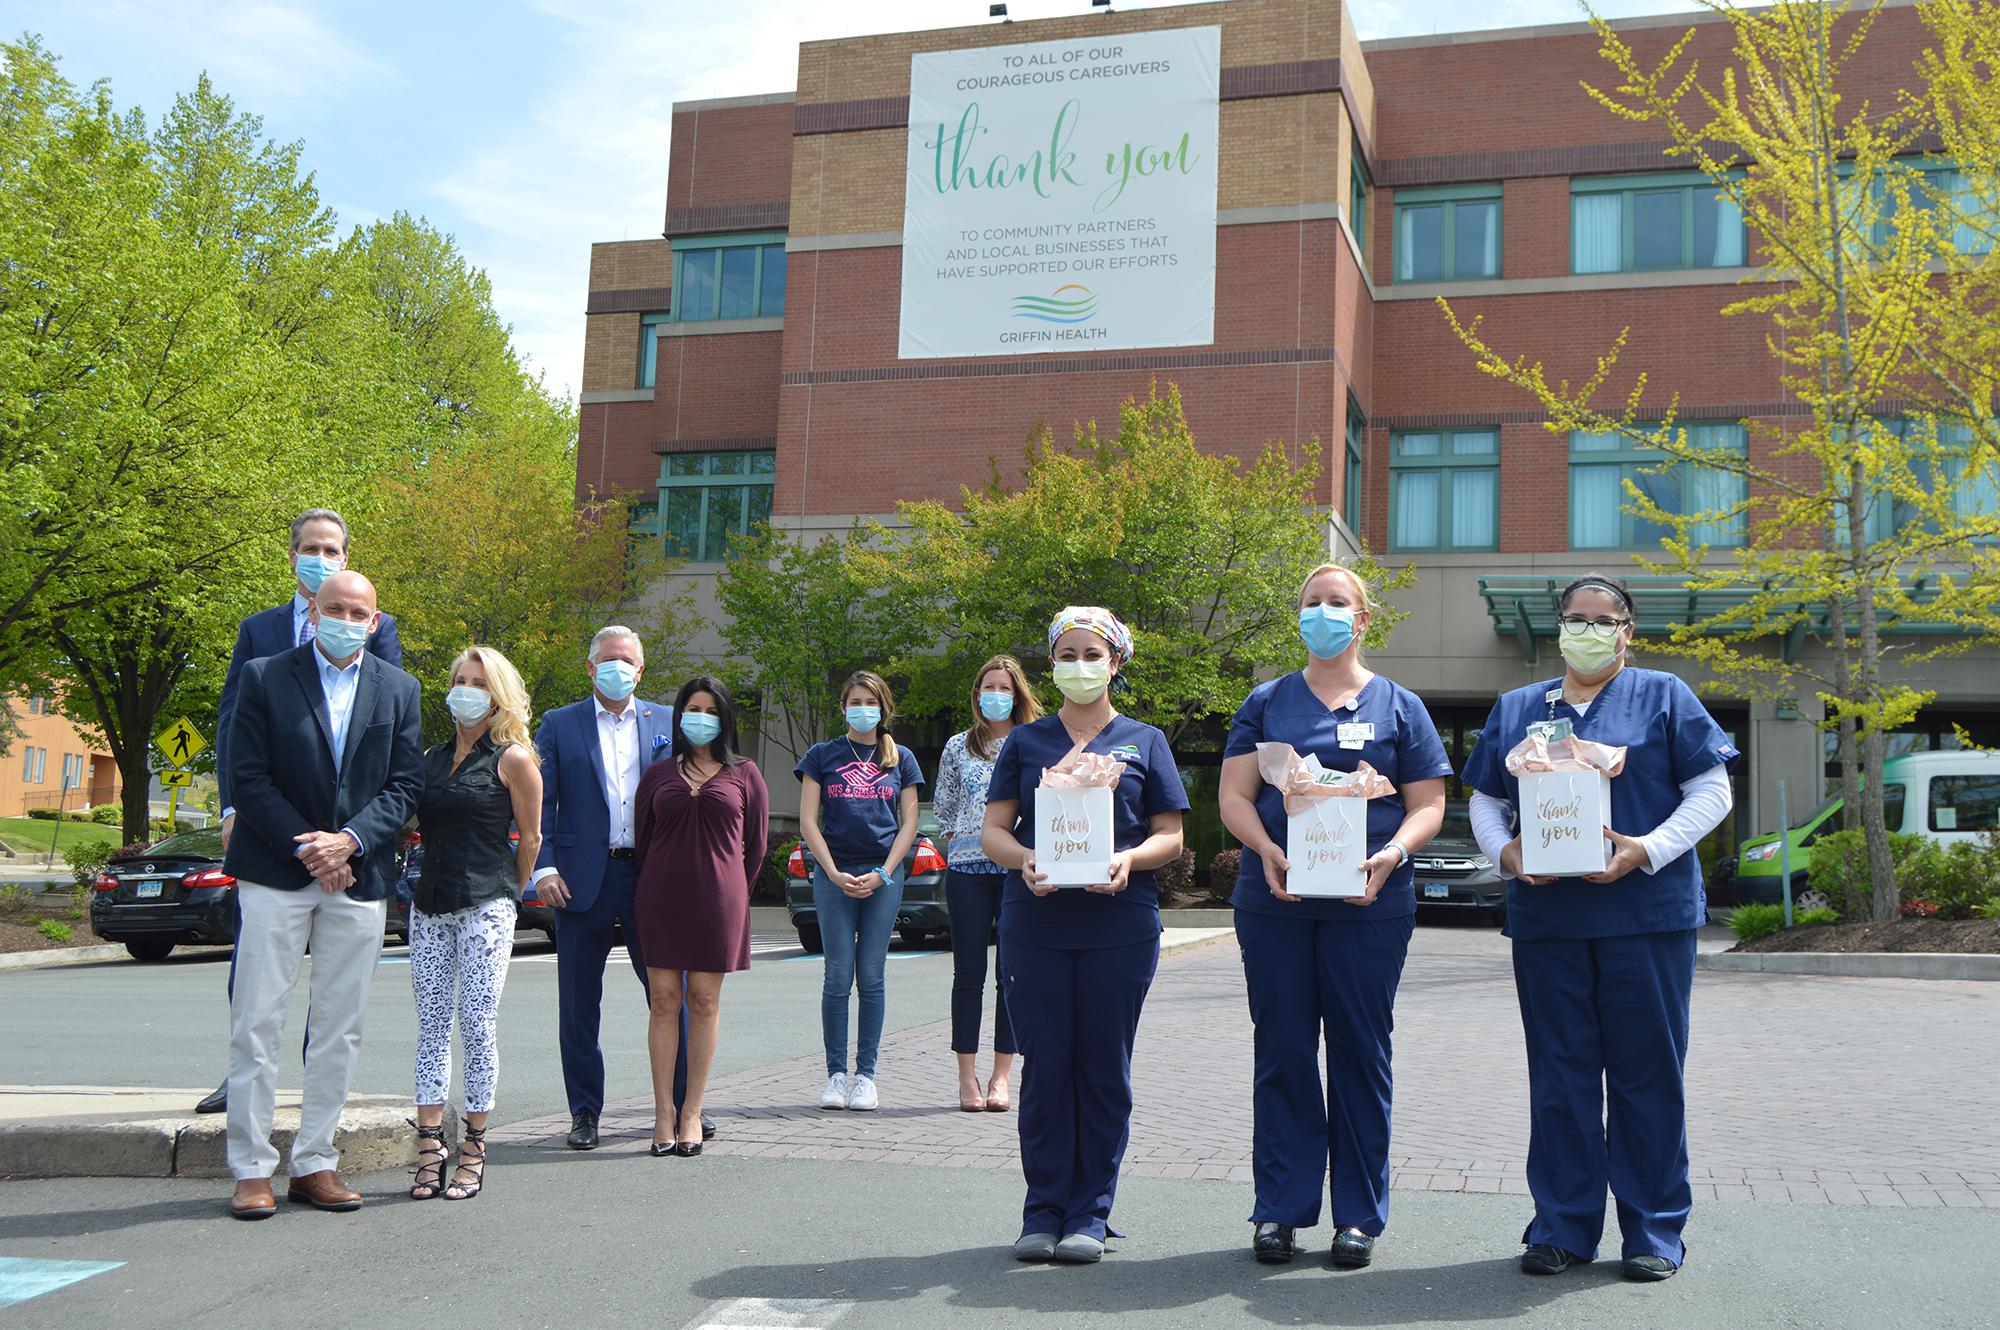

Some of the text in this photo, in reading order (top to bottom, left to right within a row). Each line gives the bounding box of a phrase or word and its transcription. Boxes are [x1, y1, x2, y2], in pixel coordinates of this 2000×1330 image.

[1003, 47, 1123, 68] TO ALL OF OUR
[956, 60, 1170, 91] COURAGEOUS CAREGIVERS
[925, 98, 1200, 213] thank you
[960, 218, 1156, 242] TO COMMUNITY PARTNERS
[946, 236, 1169, 261] AND LOCAL BUSINESSES THAT
[937, 254, 1178, 280] HAVE SUPPORTED OUR EFFORTS
[999, 327, 1107, 344] GRIFFIN HEALTH
[853, 786, 875, 795] GIRLS
[1542, 825, 1580, 848] you
[1055, 840, 1091, 861] you
[1308, 849, 1345, 871] you
